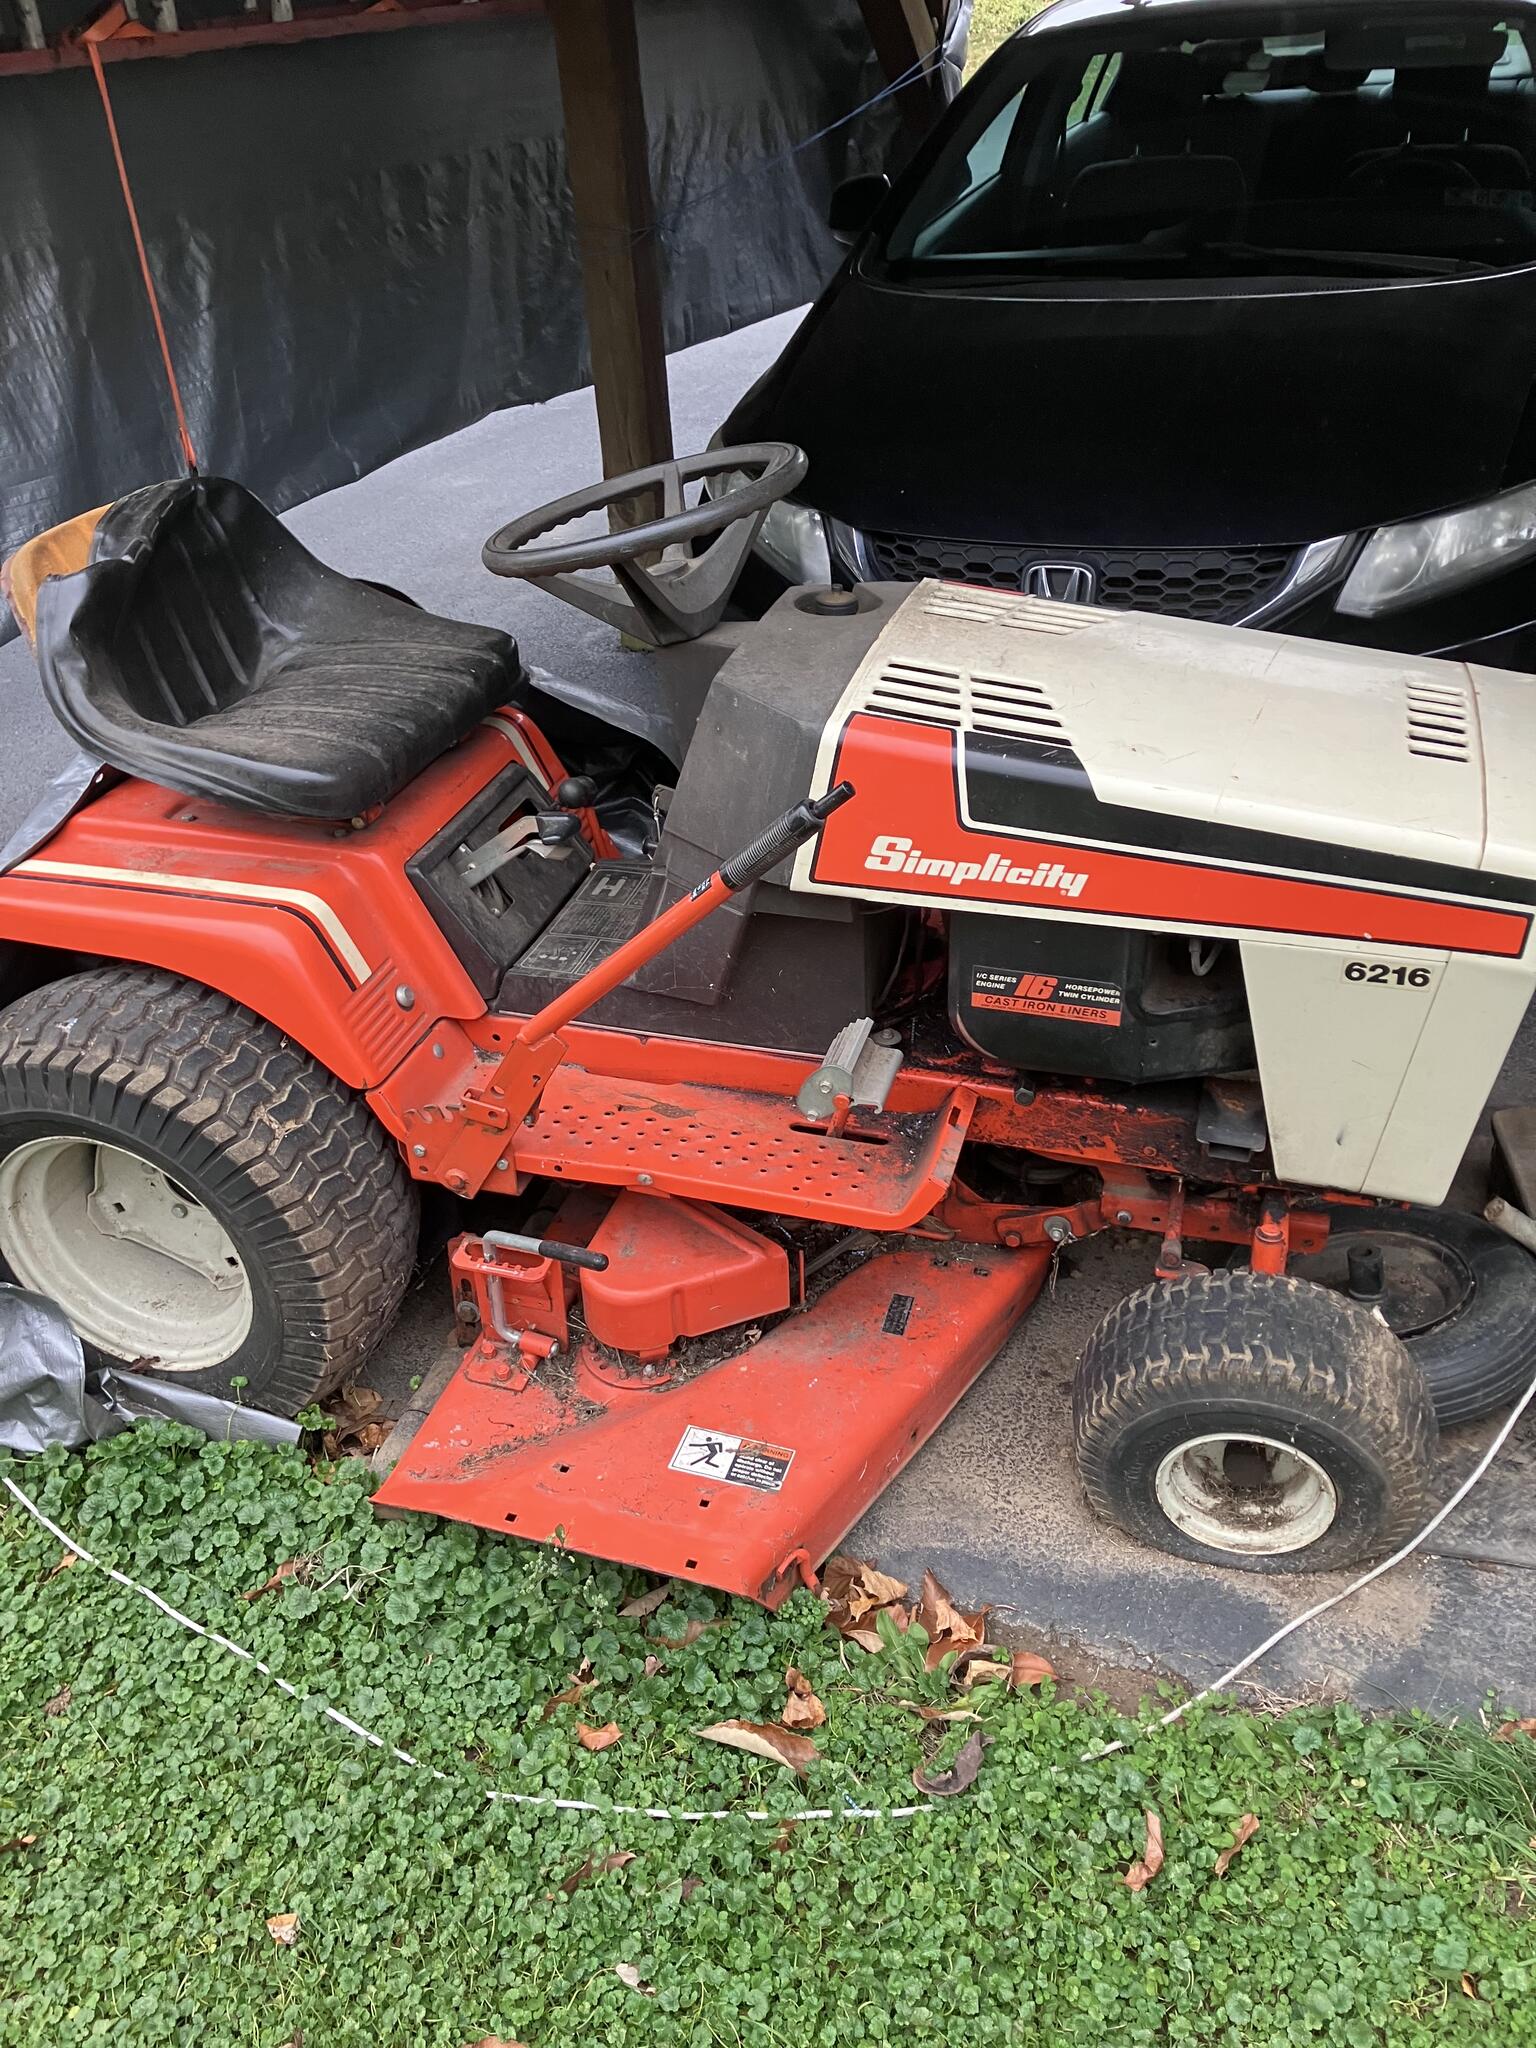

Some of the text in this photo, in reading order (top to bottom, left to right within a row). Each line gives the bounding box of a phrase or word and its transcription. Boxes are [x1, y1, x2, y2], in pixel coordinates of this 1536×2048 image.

[864, 835, 1089, 897] Simplicity
[988, 974, 1017, 984] SERIES
[1344, 962, 1431, 987] 6216
[975, 980, 1006, 990] ENGINE
[1014, 974, 1059, 999] 16
[1064, 983, 1121, 996] HORSEPOWER
[1058, 990, 1121, 1004] TWIN CYLINDER
[984, 995, 1019, 1007] CAST
[1022, 1000, 1056, 1012] IRON
[1060, 1005, 1108, 1018] LINERS
